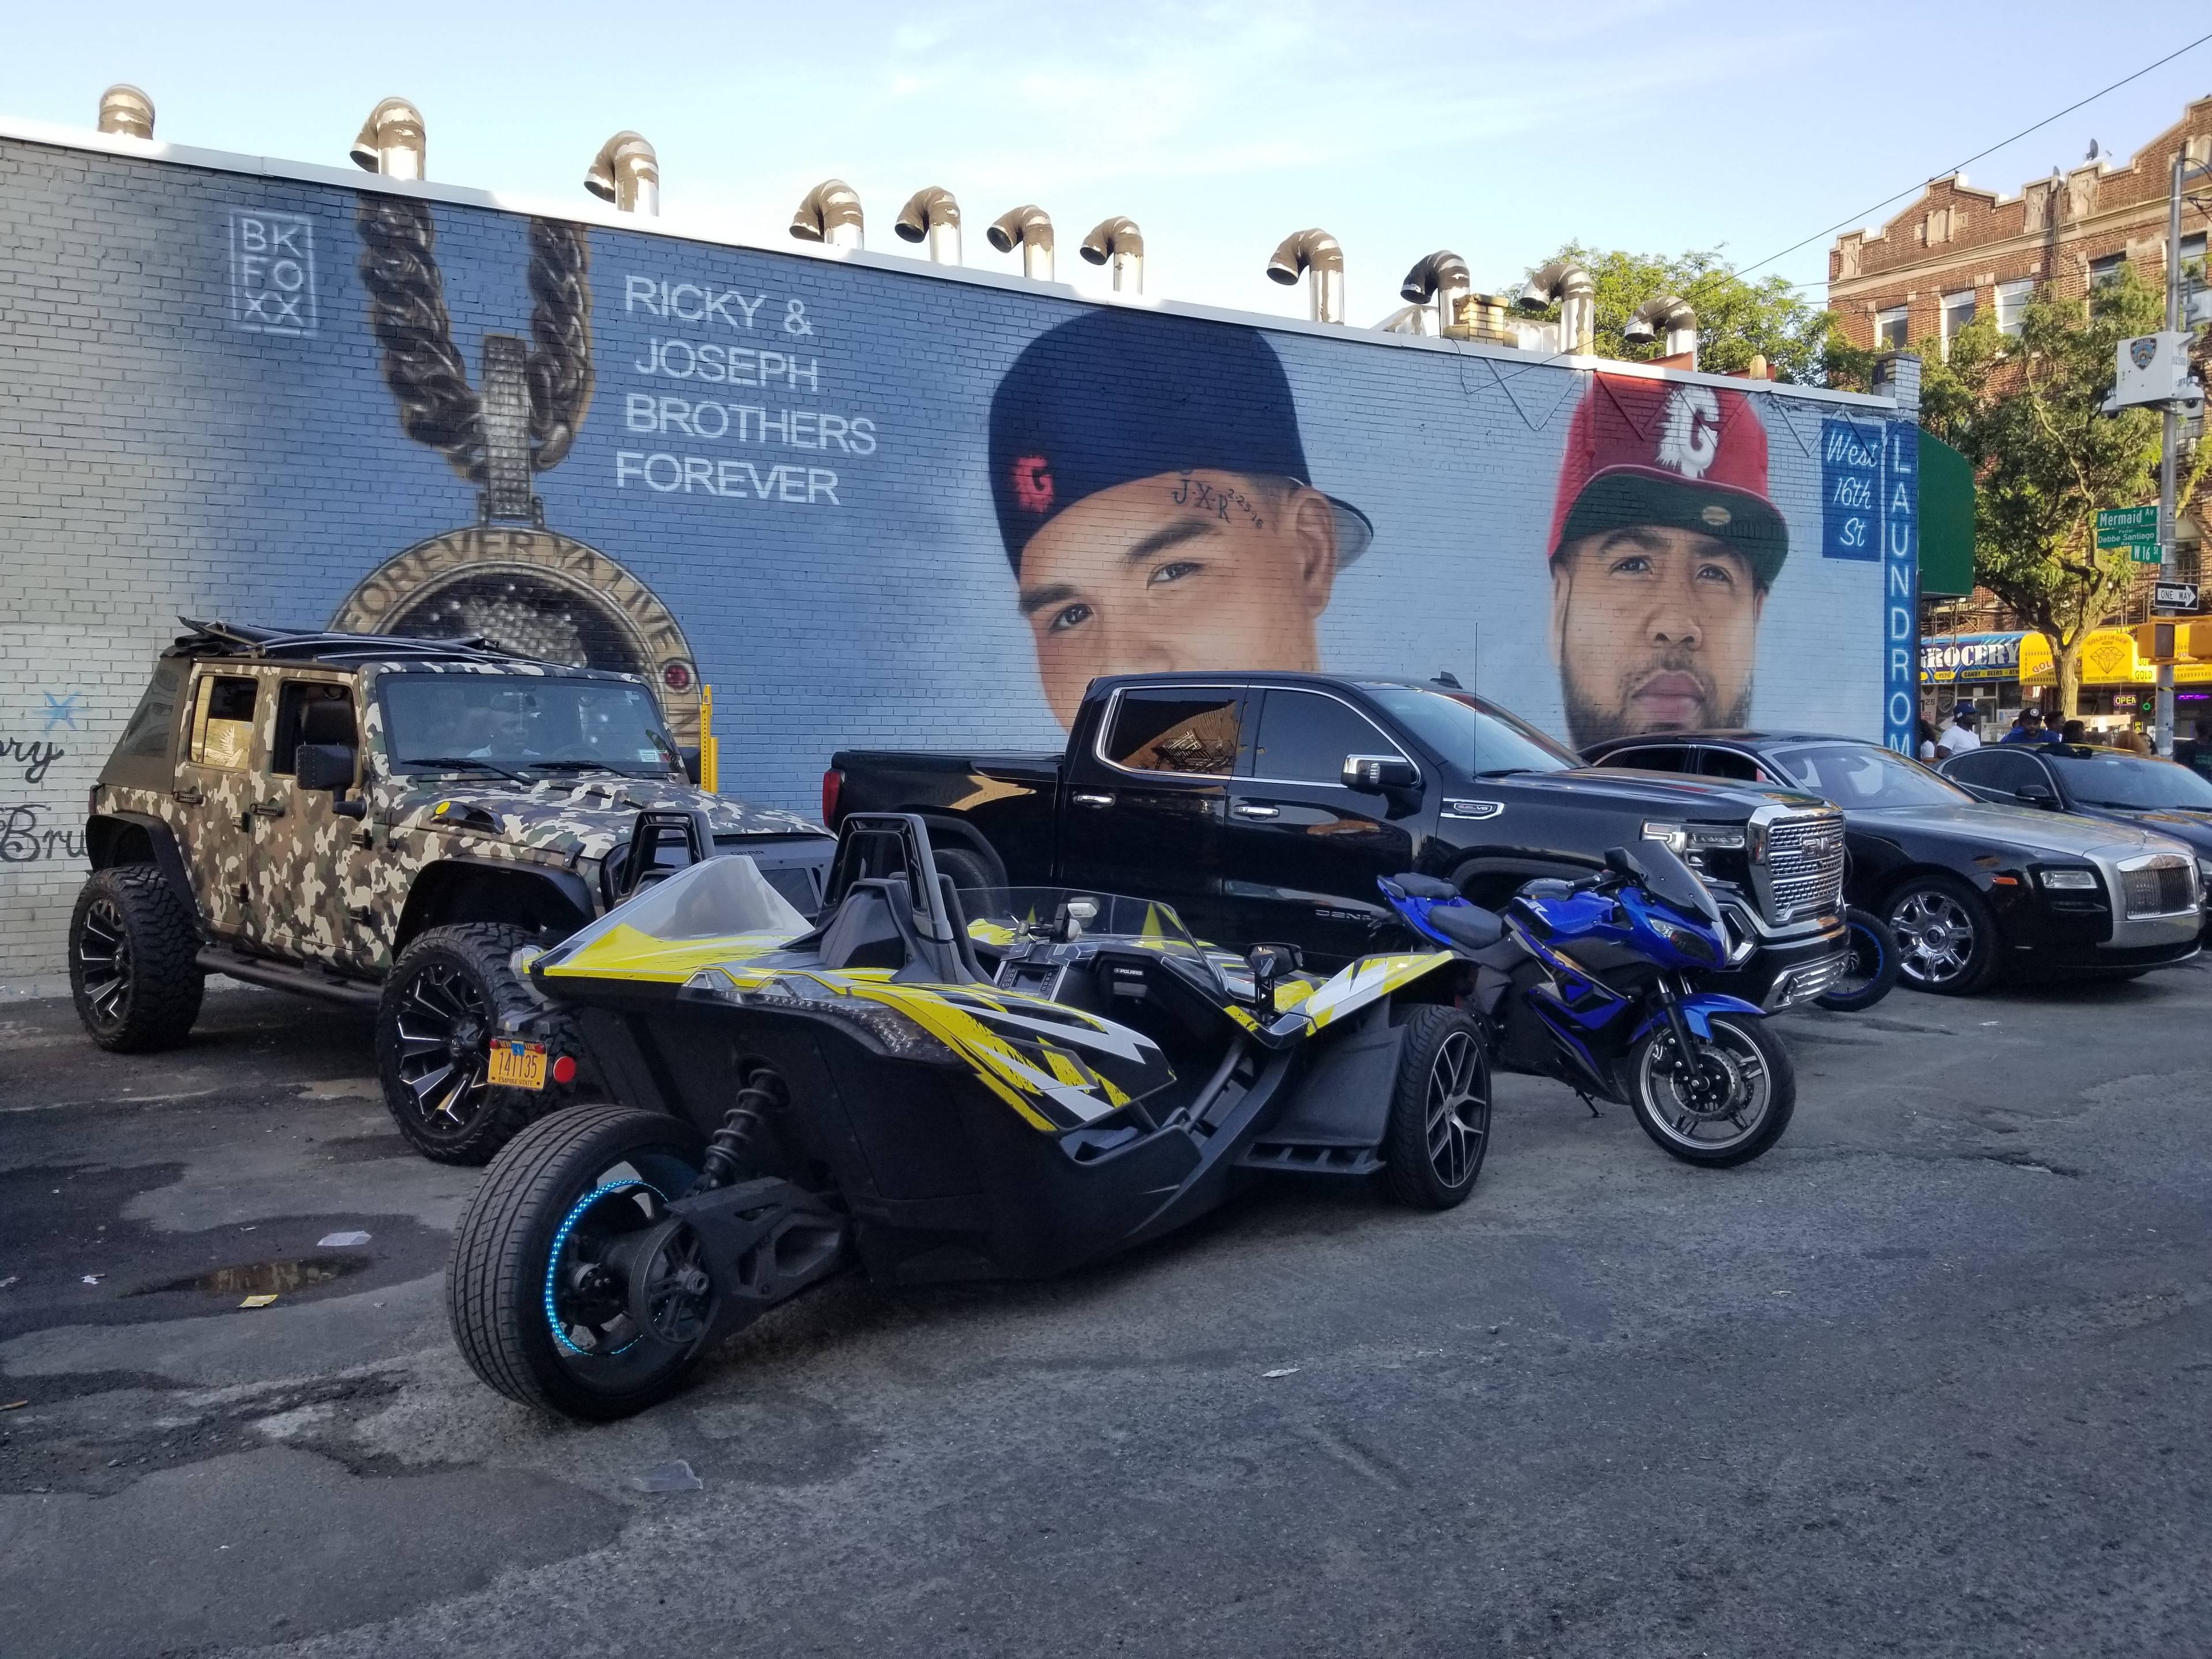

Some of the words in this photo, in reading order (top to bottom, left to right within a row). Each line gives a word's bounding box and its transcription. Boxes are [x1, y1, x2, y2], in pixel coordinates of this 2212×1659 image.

[242, 218, 304, 259] BK
[243, 255, 304, 291] FO
[244, 290, 305, 326] XX
[625, 275, 767, 329] RICKY
[784, 298, 815, 336] &
[634, 338, 818, 392] JOSEPH
[626, 393, 877, 455] BROTHERS
[1827, 425, 1879, 467] West
[616, 450, 840, 506] FOREVER
[1833, 475, 1872, 510] 16th
[1840, 517, 1866, 547] St
[2100, 510, 2142, 527] Mermaid
[2145, 508, 2154, 516] Av
[2098, 535, 2120, 544] Debbe
[2123, 532, 2154, 541] Santiago
[2134, 546, 2141, 559] W
[2142, 547, 2150, 560] 16
[2161, 590, 2173, 600] ONE
[2179, 592, 2191, 601] WAY
[2032, 661, 2055, 673] GOL
[2135, 671, 2153, 680] GOLD
[525, 1043, 536, 1051] YOR
